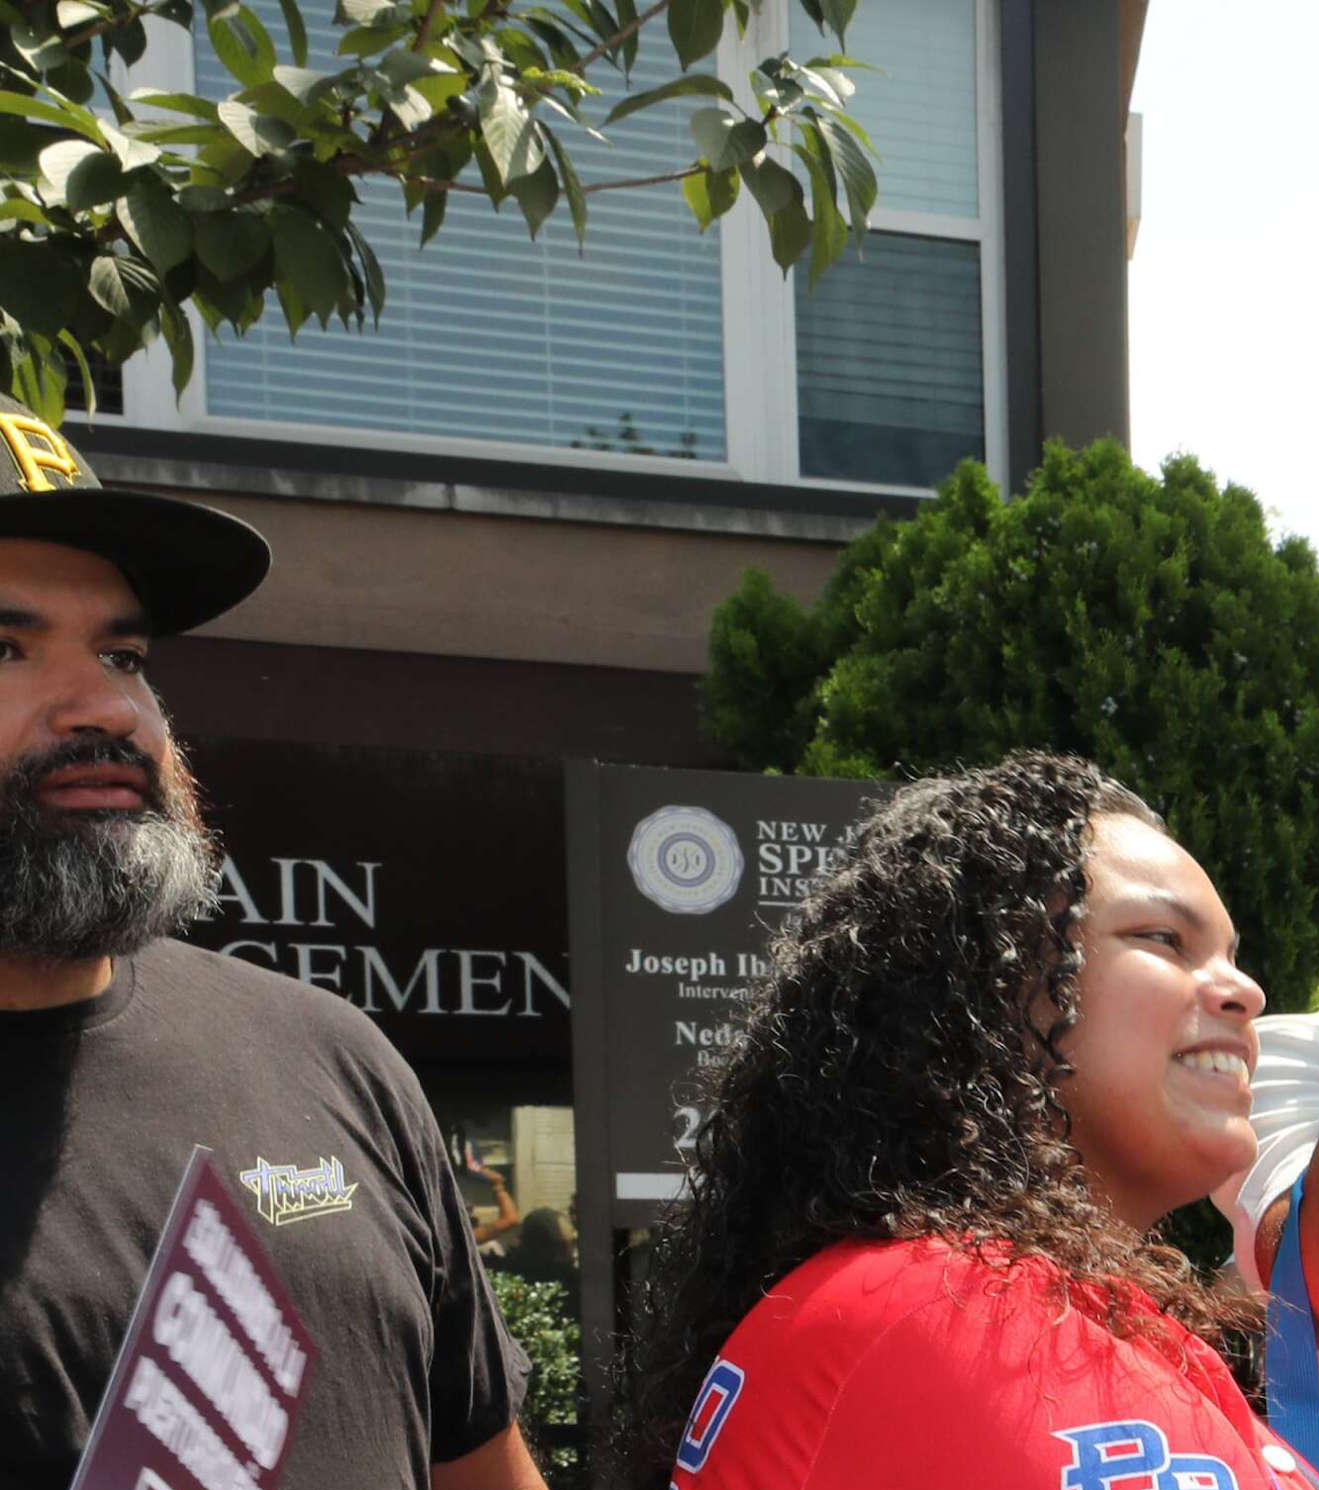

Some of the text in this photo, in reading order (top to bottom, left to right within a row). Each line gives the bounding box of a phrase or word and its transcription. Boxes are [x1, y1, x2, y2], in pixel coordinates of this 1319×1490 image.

[756, 820, 827, 843] NEW
[195, 853, 382, 928] AIN
[625, 949, 727, 981] Joseph
[672, 1106, 701, 1149] 2
